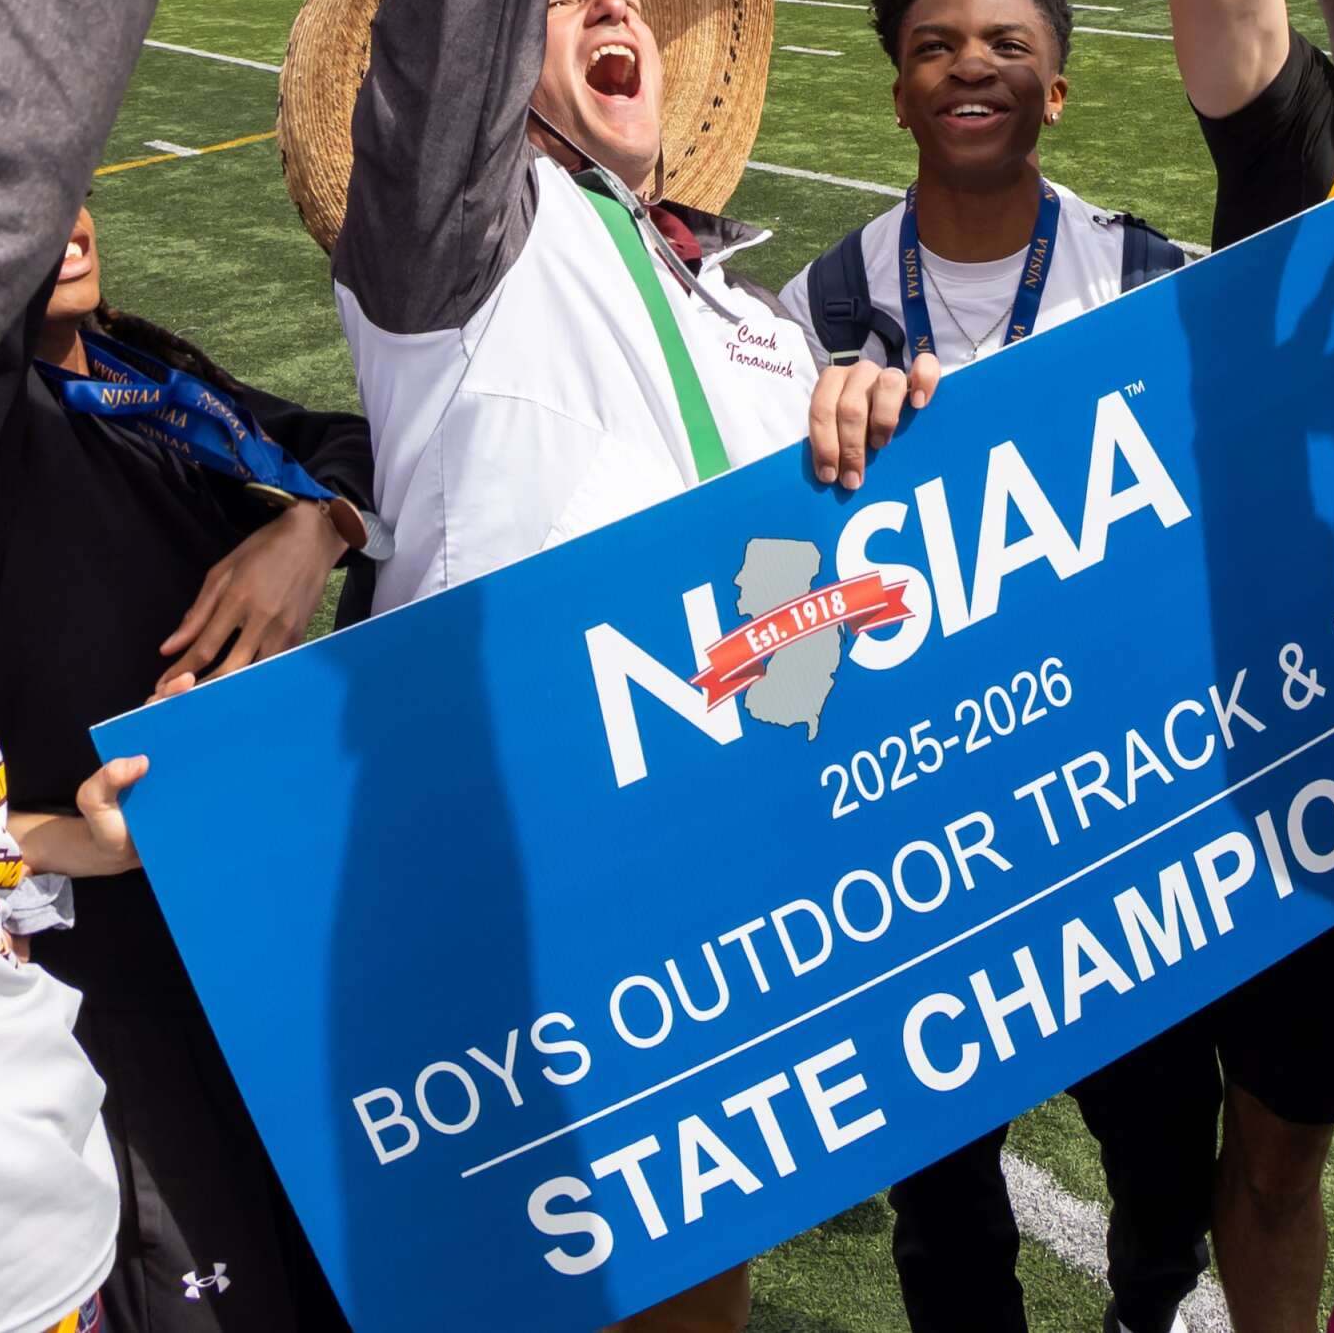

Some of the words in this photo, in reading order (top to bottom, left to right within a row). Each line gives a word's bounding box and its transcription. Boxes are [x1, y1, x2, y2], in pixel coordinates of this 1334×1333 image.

[905, 248, 920, 298] NJSIAA
[1025, 238, 1048, 288] NJSIAA
[726, 342, 794, 379] Tarasevich
[737, 324, 777, 351] Coach
[101, 388, 161, 409] NJSIAA
[745, 624, 788, 654] Est.
[790, 591, 847, 631] 1918
[821, 658, 1073, 818] 2025-2026
[352, 1011, 591, 1165] BOYS
[609, 809, 1013, 1049] OUTDOOR
[1014, 668, 1266, 848] TRACK
[1278, 642, 1327, 711] &
[527, 1038, 886, 1275] STATE
